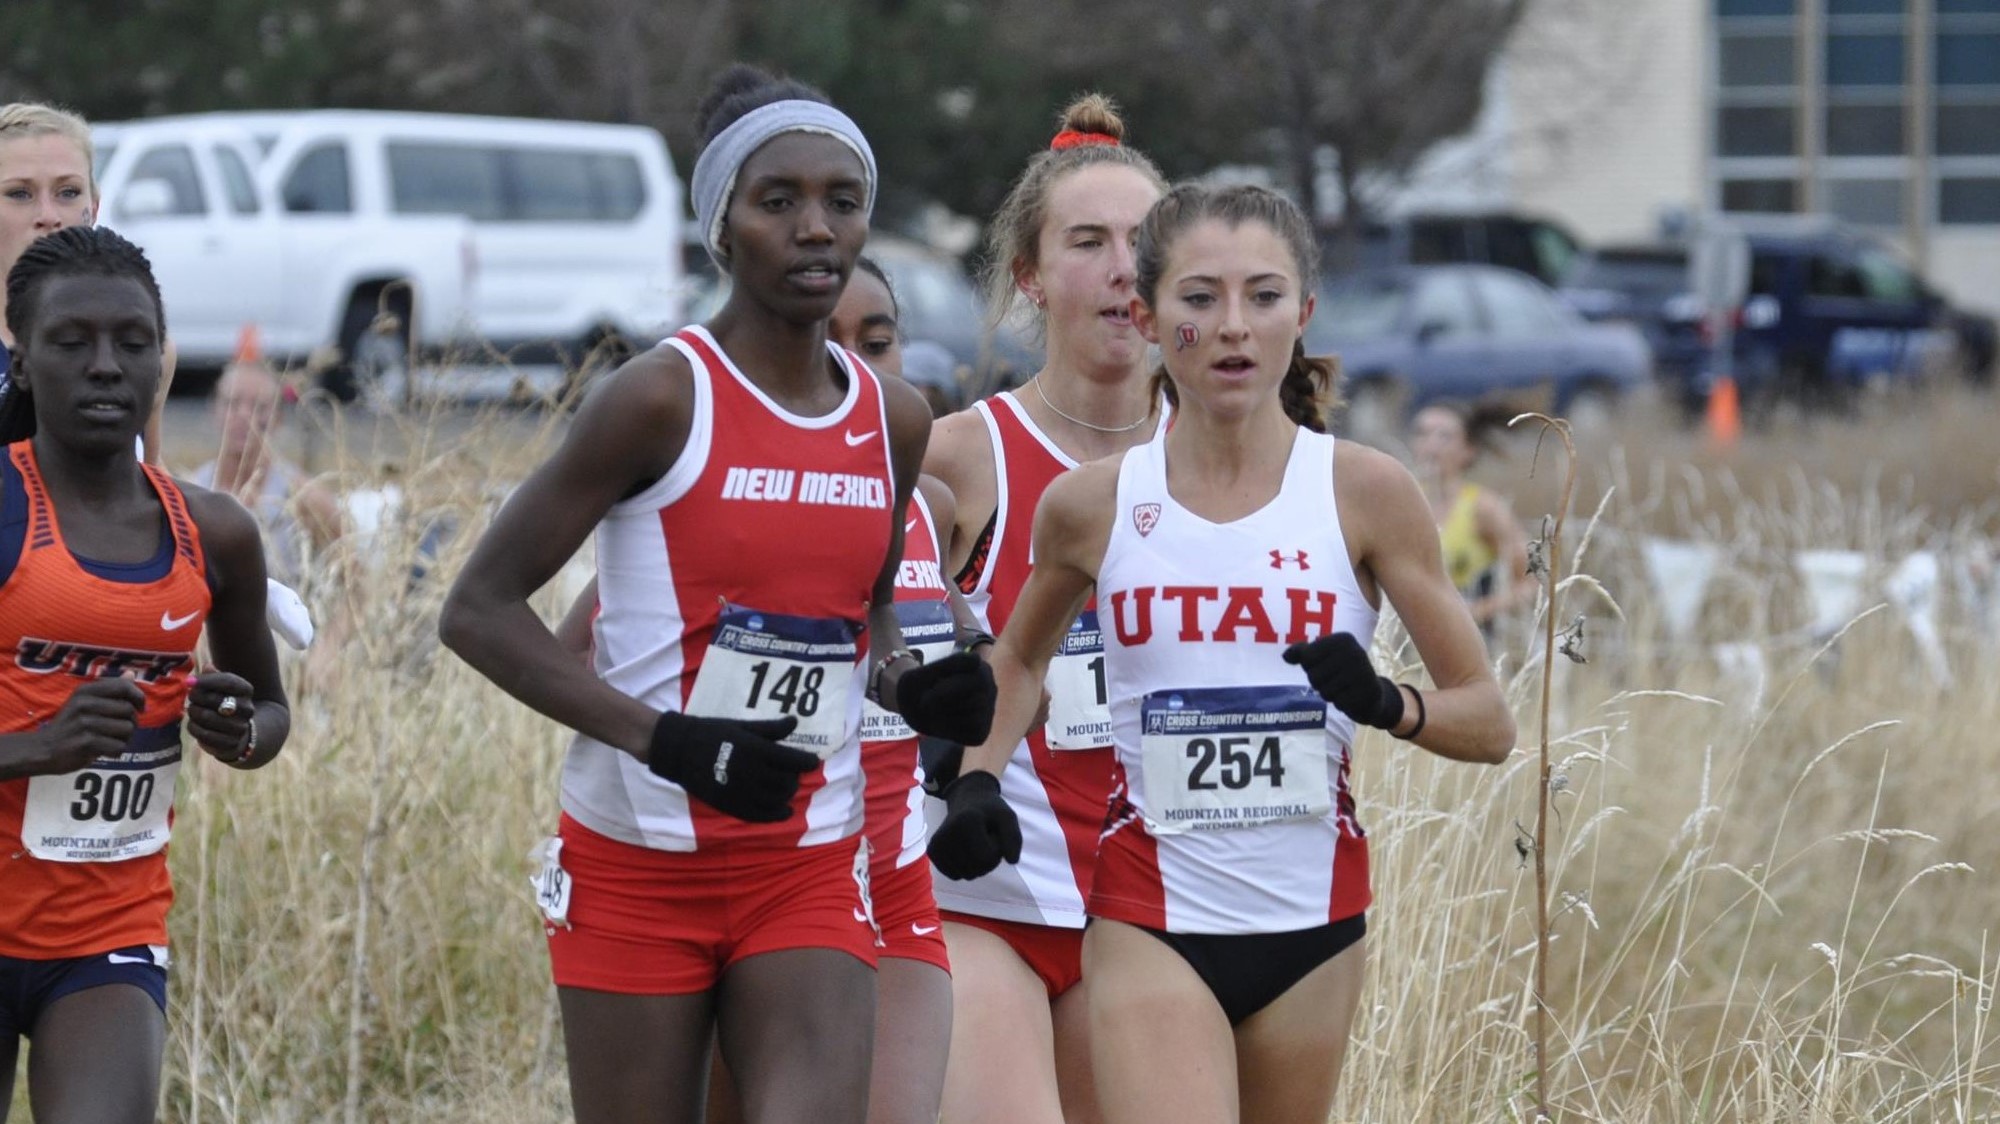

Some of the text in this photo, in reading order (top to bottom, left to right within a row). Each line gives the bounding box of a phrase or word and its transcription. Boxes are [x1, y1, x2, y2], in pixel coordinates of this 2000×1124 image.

[720, 466, 887, 509] NEW MEXICO
[1134, 504, 1160, 521] PAC
[1139, 518, 1155, 533] 12
[1110, 586, 1337, 647] UTAH
[1067, 634, 1096, 648] CROSS
[745, 661, 825, 717] 148
[1165, 711, 1323, 727] CROSS COUNTRY CHAMPIONSHIPS
[1066, 721, 1113, 737] MOUNT
[1186, 736, 1286, 791] 254
[70, 772, 155, 822] 300
[1164, 804, 1311, 821] MOUNTAIN REGIONAL
[41, 835, 110, 849] MOUNTAIN
